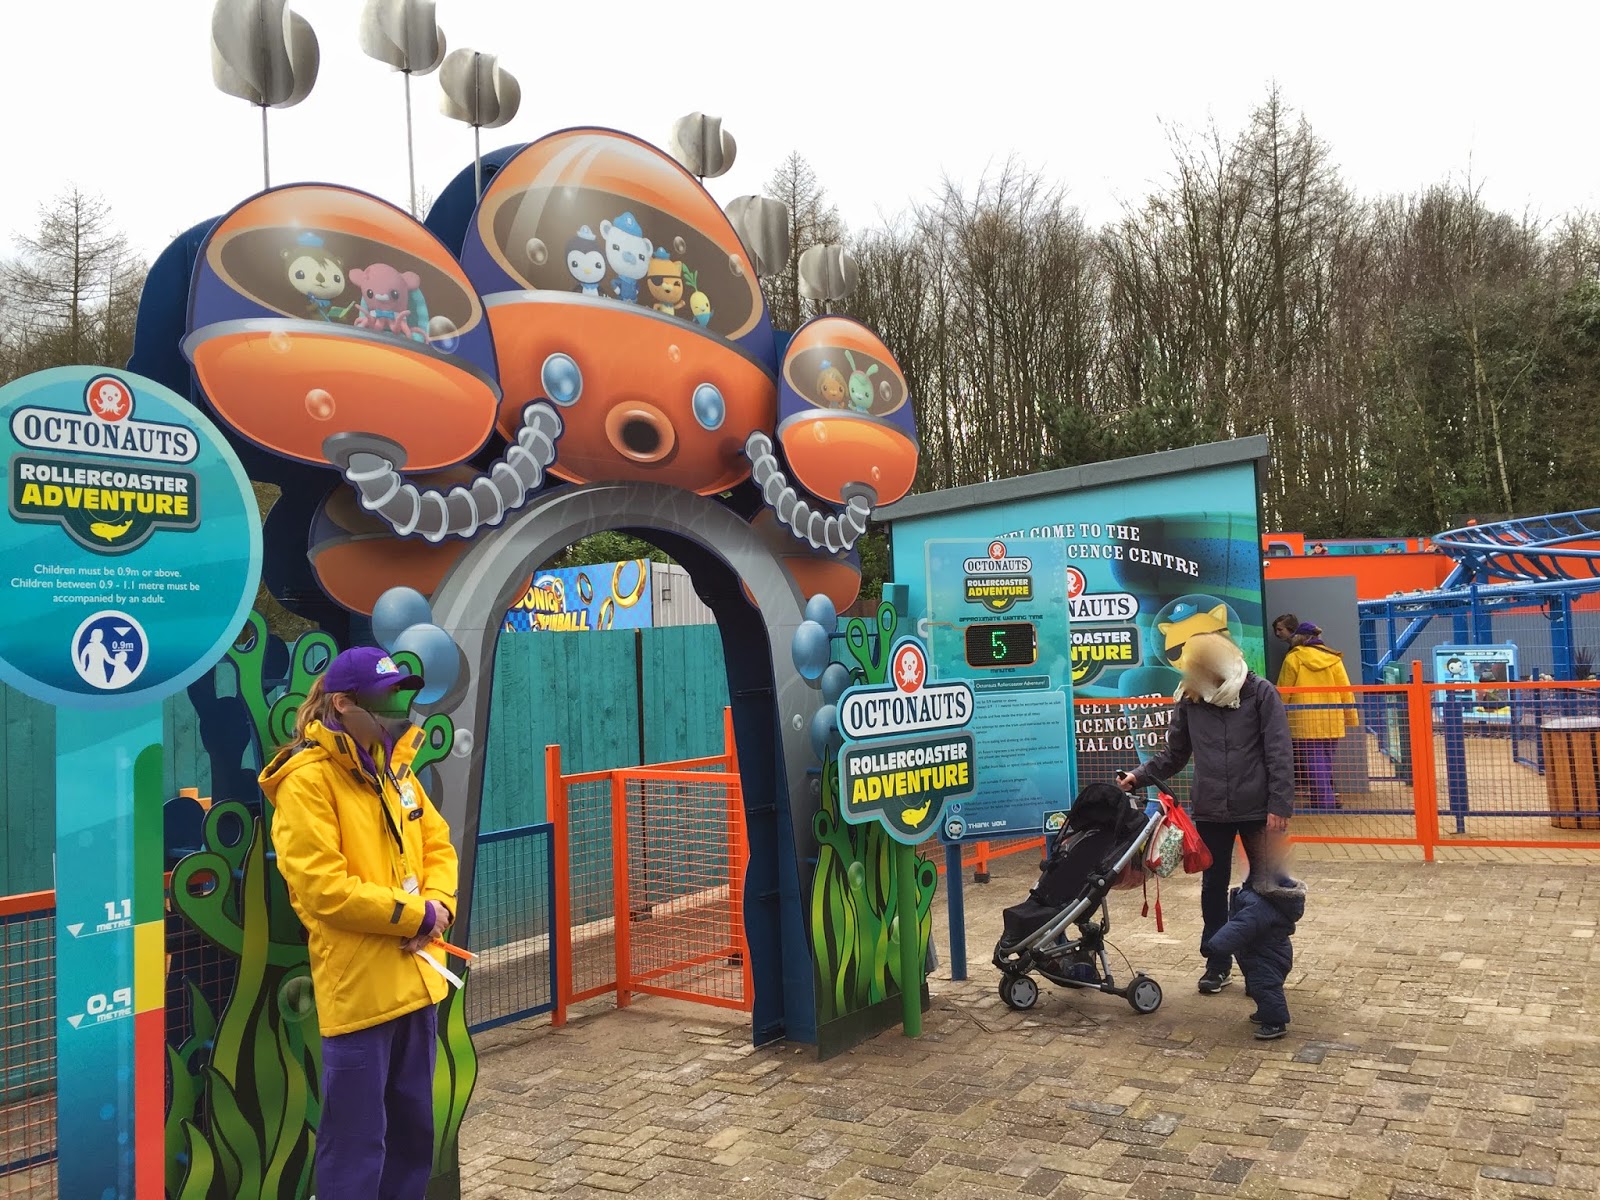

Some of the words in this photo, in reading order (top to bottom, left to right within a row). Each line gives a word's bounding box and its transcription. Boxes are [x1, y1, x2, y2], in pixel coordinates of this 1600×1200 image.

[24, 414, 188, 456] OCTONAUTS
[20, 463, 188, 493] ROLLERCOASTER
[21, 483, 188, 516] ADVENTURE
[994, 524, 1075, 539] COME
[1080, 524, 1100, 538] TO
[1106, 524, 1140, 541] THE
[967, 560, 1028, 571] OCTONAUTS
[1129, 547, 1199, 577] CENTRE
[34, 564, 75, 575] Children
[79, 567, 101, 576] must
[104, 567, 115, 576] be
[117, 567, 139, 577] 0.9m
[142, 569, 151, 577] or
[155, 568, 182, 578] above.
[11, 578, 53, 589] Children
[56, 579, 96, 589] between
[99, 580, 113, 589] 0.9
[123, 581, 135, 590] 1.1
[138, 582, 164, 591] metre
[167, 582, 188, 591] must
[190, 582, 200, 591] be
[967, 578, 1028, 587] ROLLERCOASTER
[968, 586, 1029, 596] ADVENTURE
[53, 594, 113, 605] accompanied
[116, 594, 126, 605] by
[129, 596, 139, 604] an
[142, 595, 165, 604] adult.
[112, 641, 134, 650] 0.9m
[992, 631, 1007, 659] 5
[1070, 631, 1131, 645] OASTER
[850, 691, 966, 730] OCTONAUTS
[1075, 737, 1108, 752] IAL
[850, 743, 968, 776] ROLLERCOASTER
[852, 762, 969, 804] ADVENTURE
[105, 899, 131, 921] 1.1
[96, 918, 131, 932] METRE
[87, 987, 131, 1015] 0.9
[96, 1008, 131, 1023] METRE
